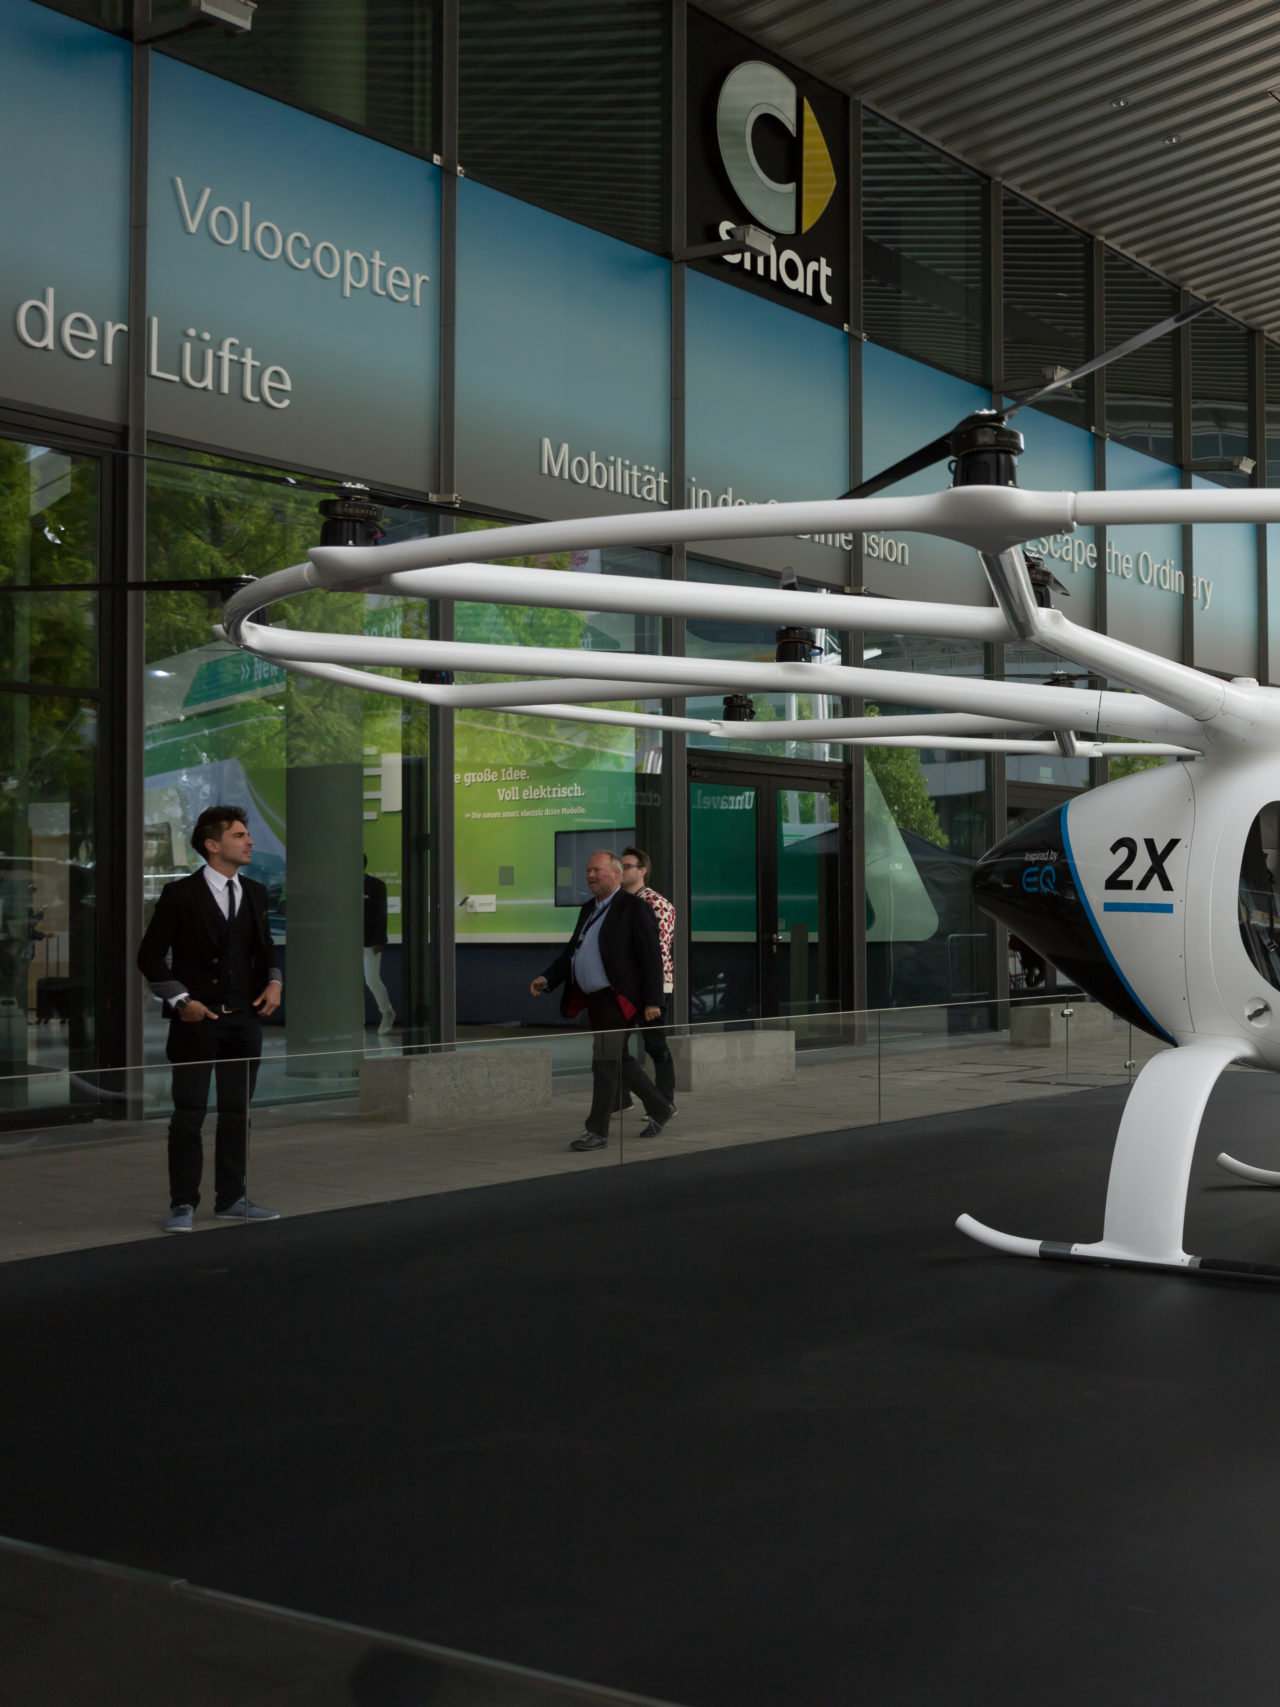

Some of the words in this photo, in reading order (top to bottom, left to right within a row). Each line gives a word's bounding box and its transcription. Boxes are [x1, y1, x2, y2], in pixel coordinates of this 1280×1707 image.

[173, 176, 429, 307] Volocopter
[16, 287, 128, 365] der
[149, 316, 292, 409] Lüfte
[541, 437, 669, 505] Mobilität
[1025, 535, 1098, 574] scape
[1105, 541, 1133, 579] the
[464, 768, 498, 787] große
[501, 767, 530, 782] Idee.
[498, 786, 519, 801] Voll
[522, 782, 585, 800] elektrisch.
[1024, 849, 1050, 863] Inspired
[1049, 849, 1059, 863] by
[1104, 836, 1182, 892] 2X
[1022, 865, 1056, 893] EQ
